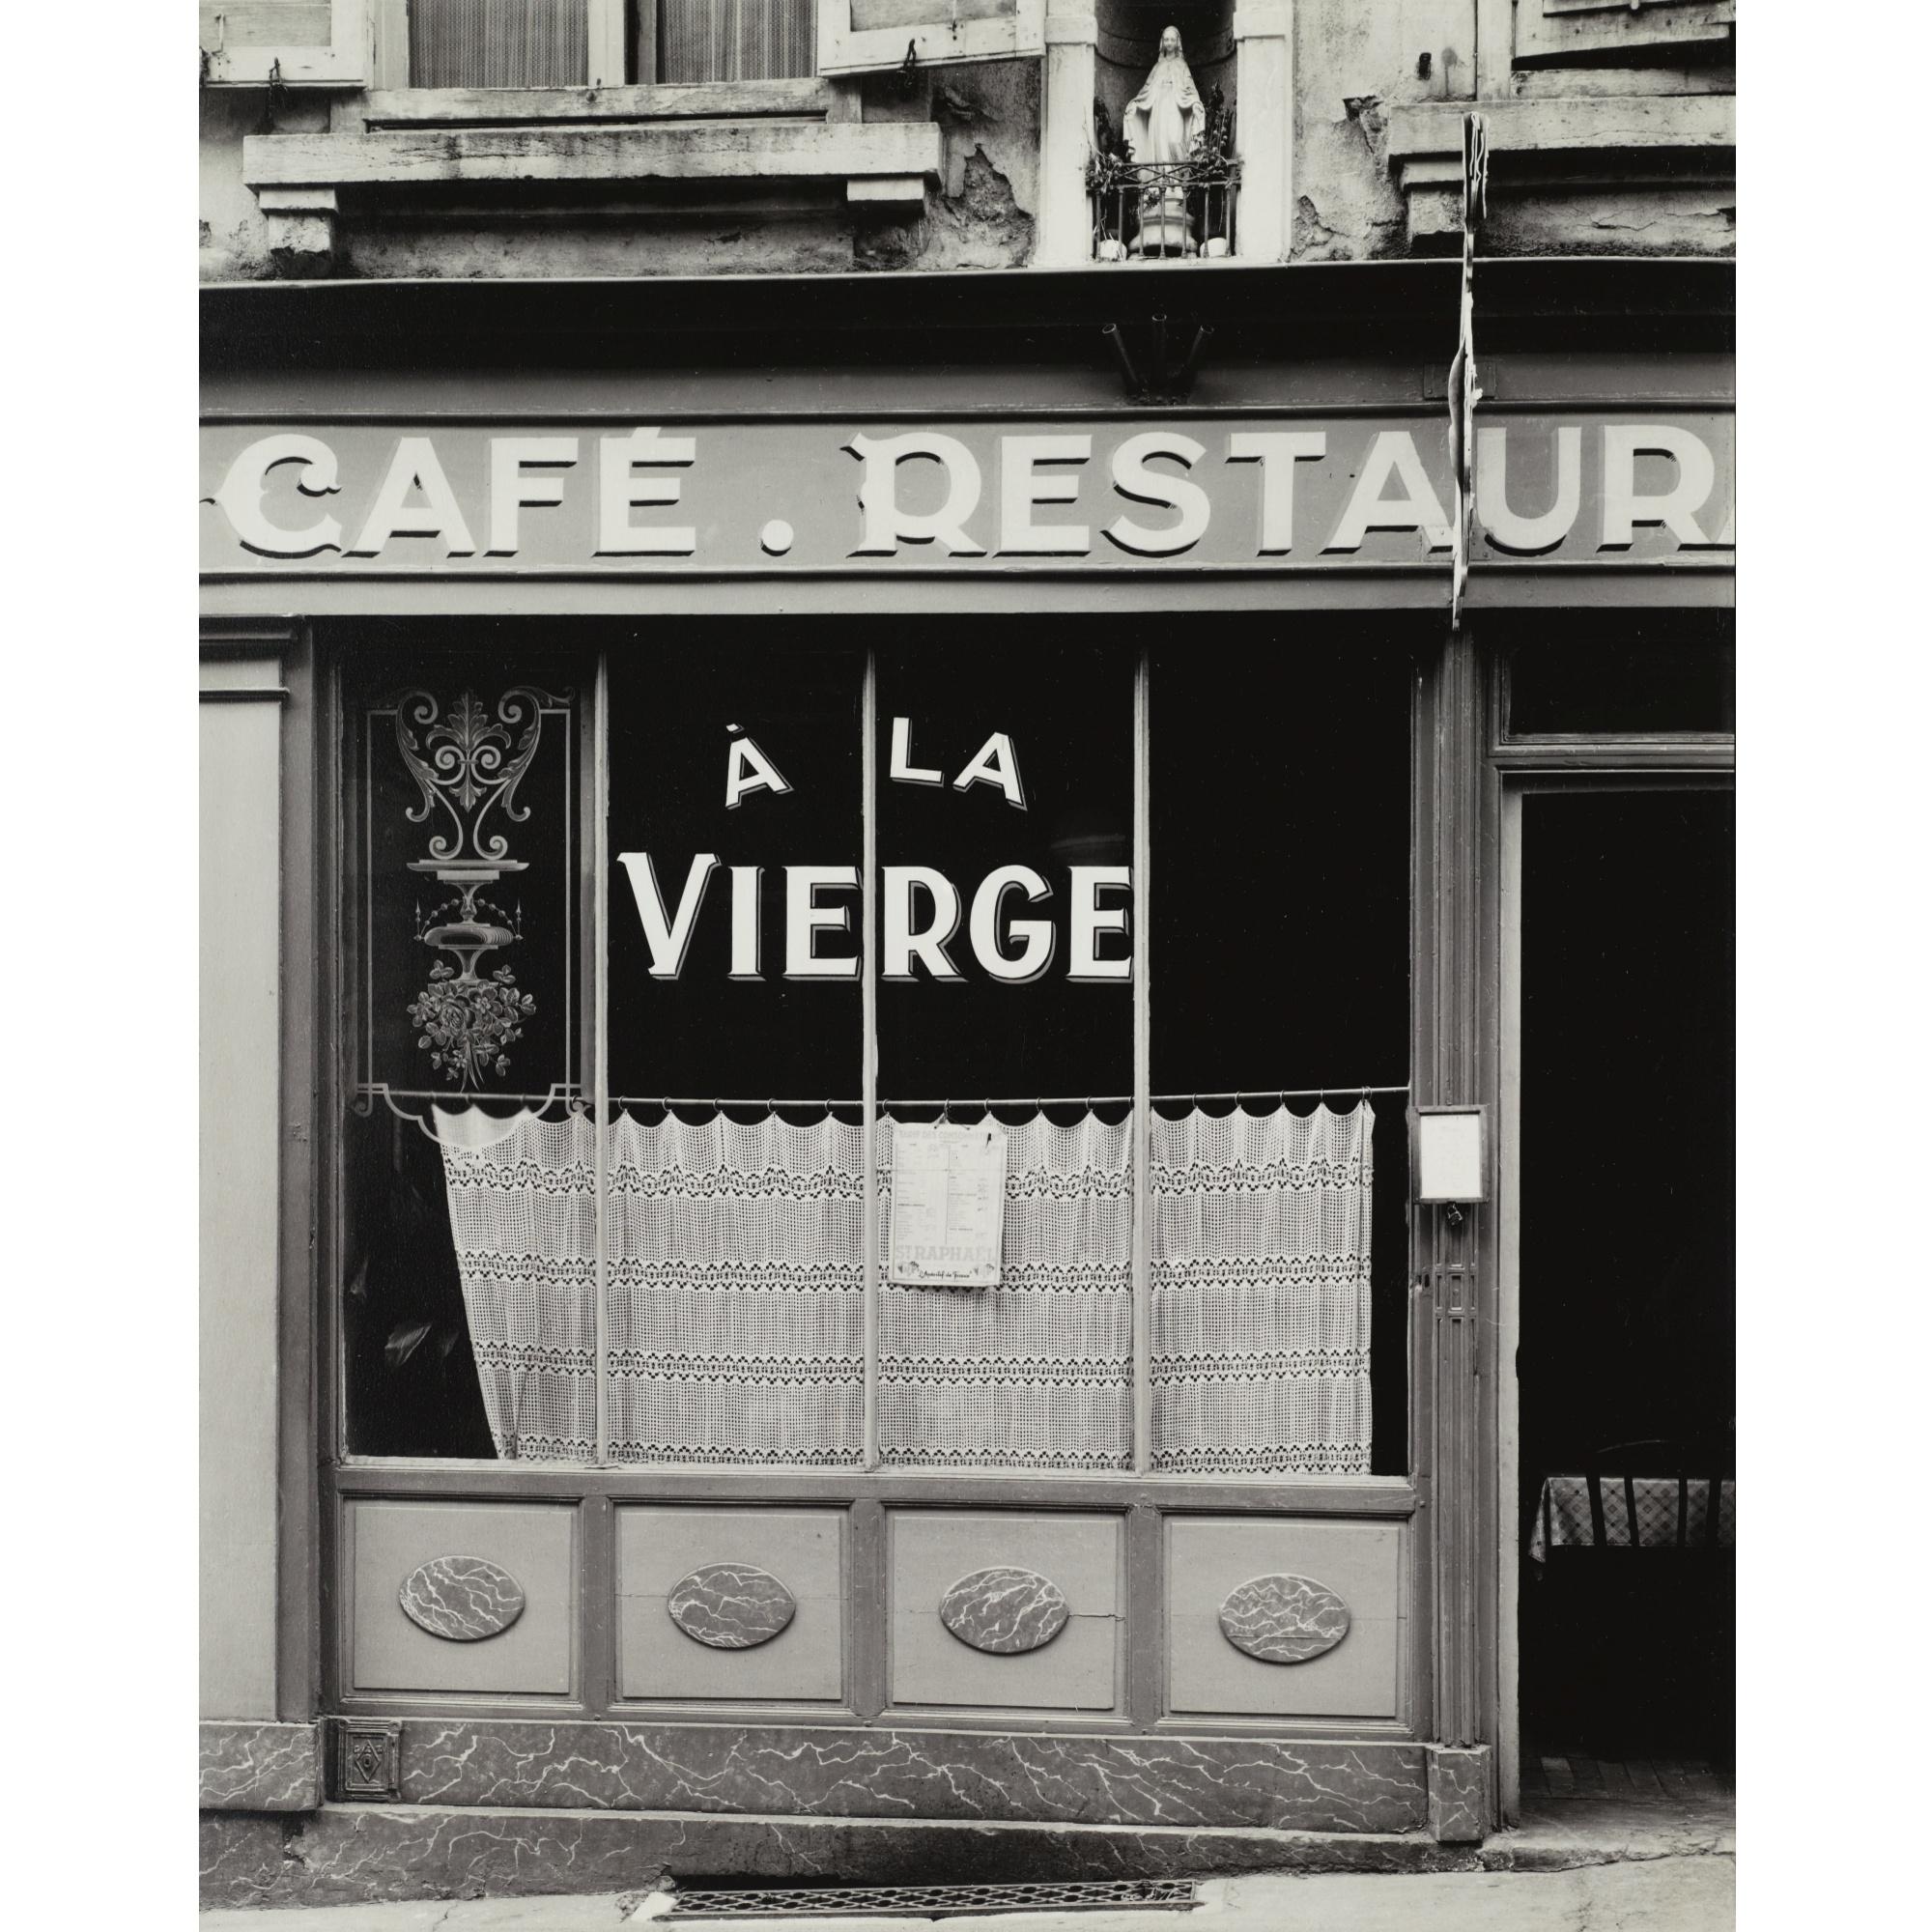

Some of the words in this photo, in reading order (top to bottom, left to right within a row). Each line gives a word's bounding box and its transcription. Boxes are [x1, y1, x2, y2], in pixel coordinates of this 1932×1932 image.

[214, 427, 696, 557] CAFÉ
[840, 425, 1735, 557] RESTAUR
[725, 723, 794, 810] À
[890, 717, 1028, 811] LA
[616, 850, 1133, 984] VIERGE
